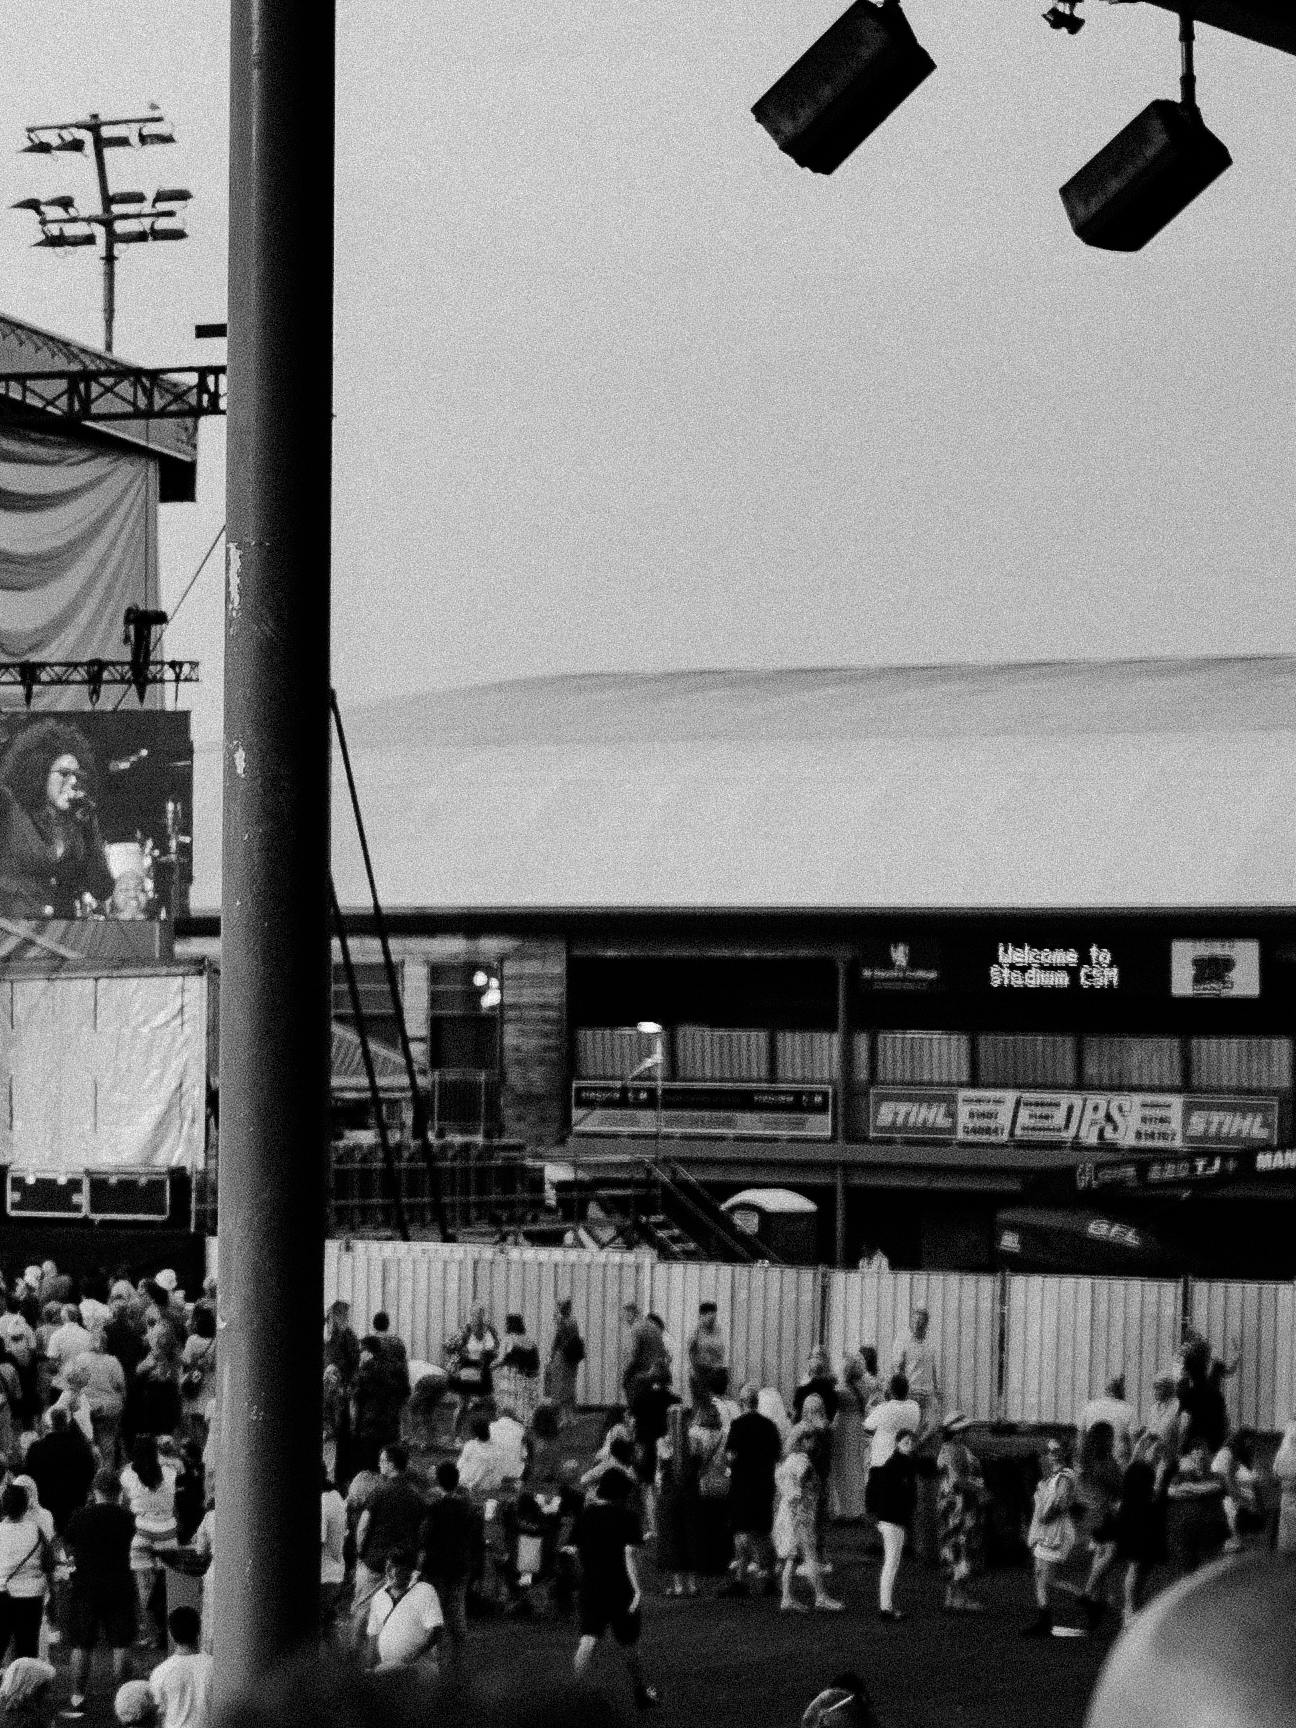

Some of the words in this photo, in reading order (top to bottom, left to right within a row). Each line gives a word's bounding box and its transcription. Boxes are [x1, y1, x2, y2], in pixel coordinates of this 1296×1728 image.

[998, 943, 1079, 966] Welcome
[1089, 943, 1111, 966] to
[990, 964, 1070, 988] Stadium
[1080, 964, 1119, 988] CSM
[876, 1101, 953, 1128] STIHL
[1185, 1110, 1270, 1139] STIHL
